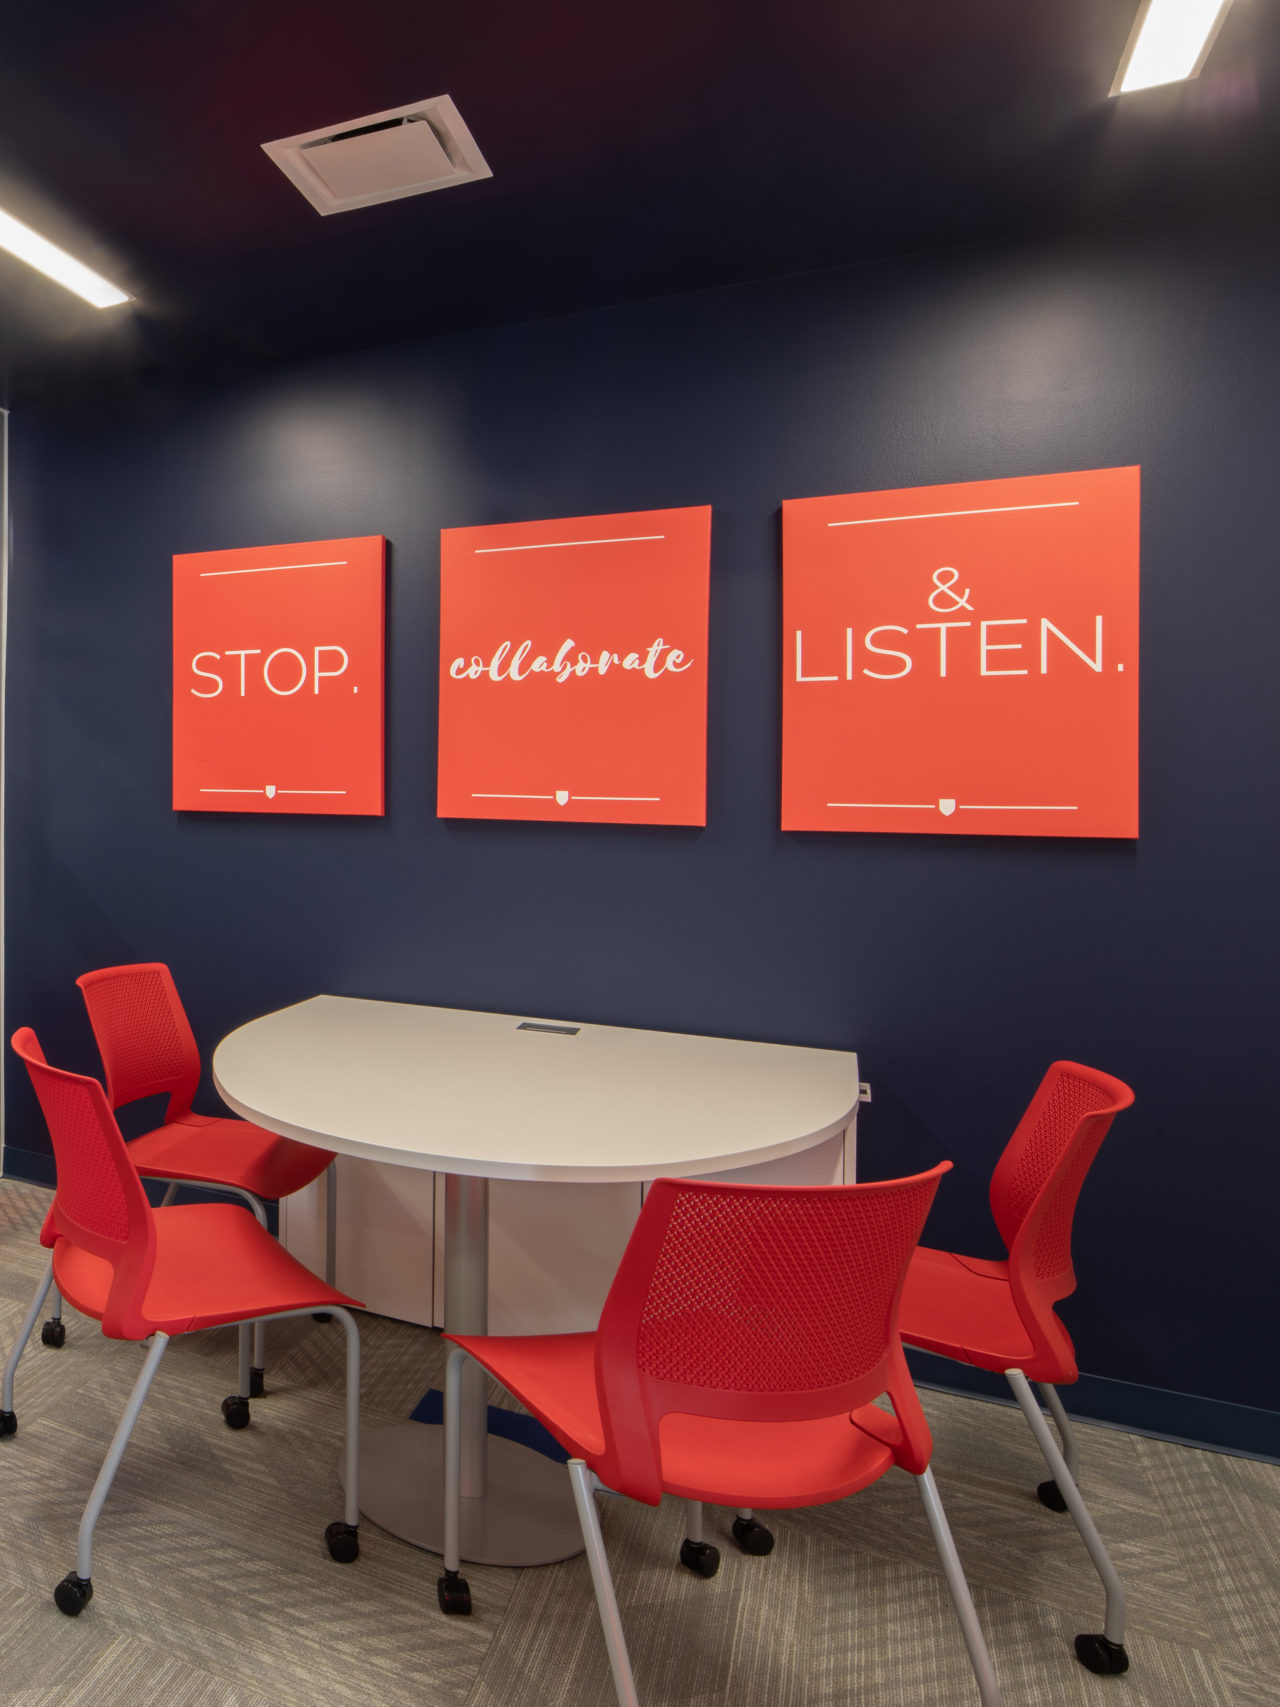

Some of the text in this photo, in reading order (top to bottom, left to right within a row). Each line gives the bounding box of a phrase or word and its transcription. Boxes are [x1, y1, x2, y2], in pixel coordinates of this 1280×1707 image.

[928, 566, 975, 613] &
[191, 645, 359, 698] STOP.
[449, 637, 694, 683] collaborate
[795, 615, 1124, 682] LISTEN.
